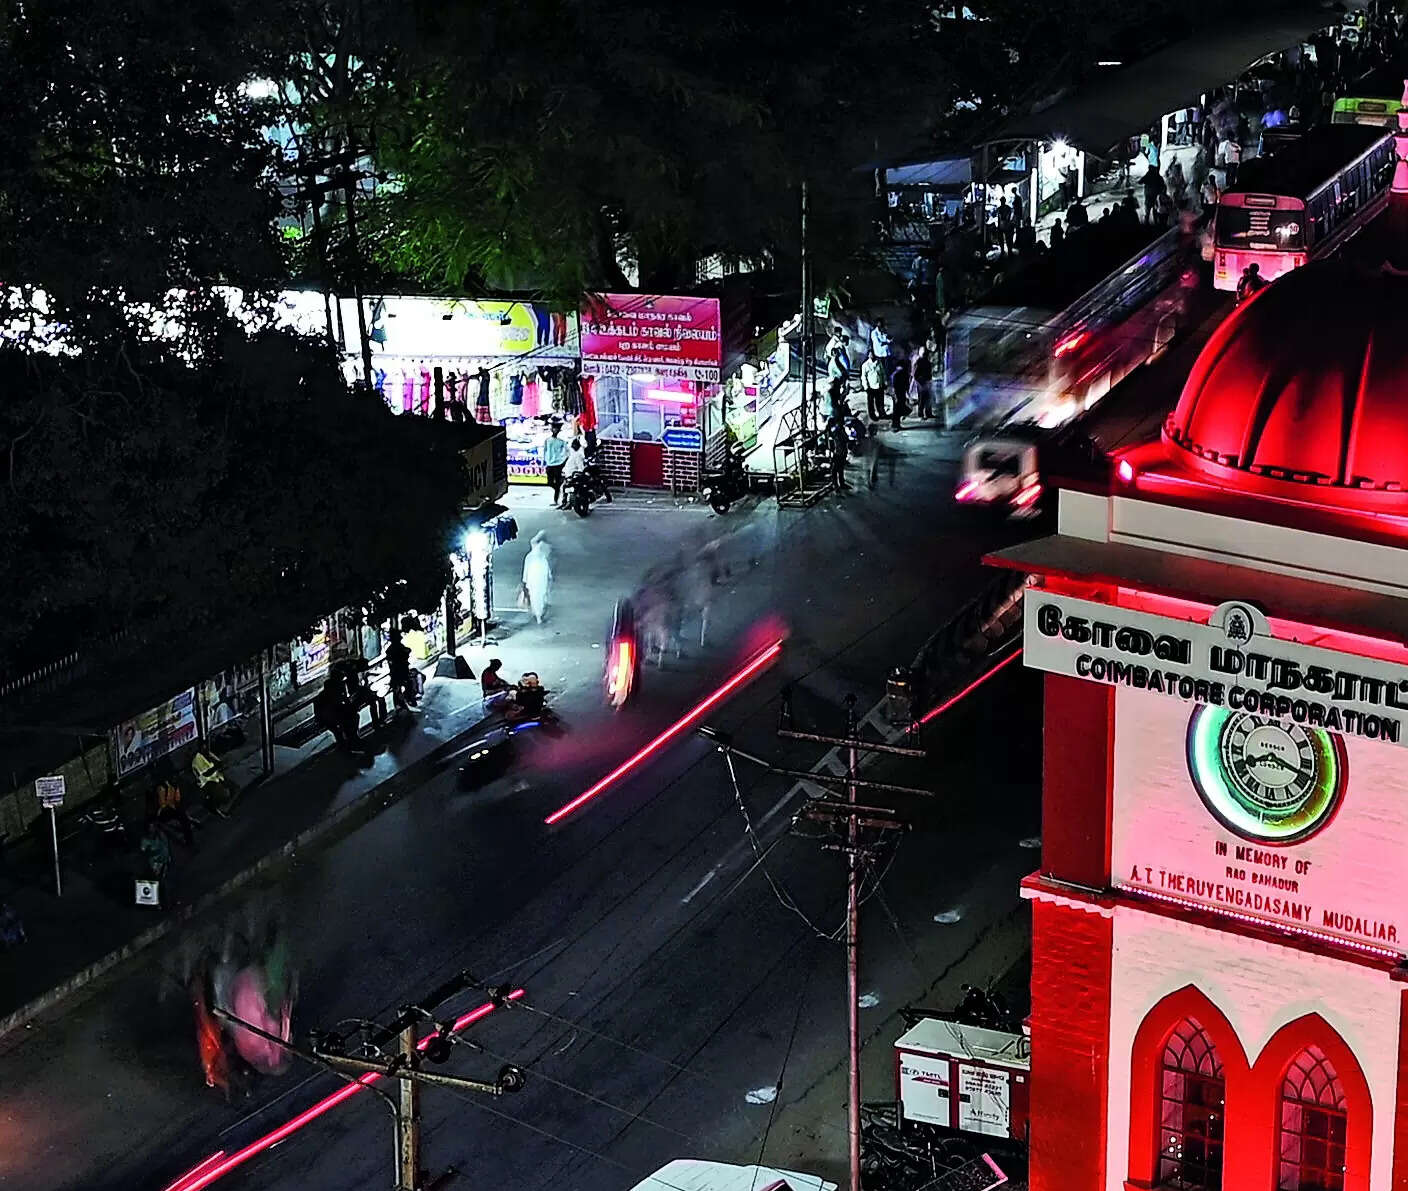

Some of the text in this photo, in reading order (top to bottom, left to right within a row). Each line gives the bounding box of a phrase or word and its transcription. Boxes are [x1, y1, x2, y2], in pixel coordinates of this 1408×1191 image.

[640, 323, 673, 339] காவல்
[673, 323, 717, 341] நிலையம்
[1036, 603, 1192, 666] கோவை
[1075, 654, 1401, 743] COIMBATORE CORPORATION
[1215, 840, 1312, 875] IN MEMORY OF
[1159, 870, 1313, 923] THERUVENGADASAMY
[1226, 866, 1299, 894] RAO BAHADUR
